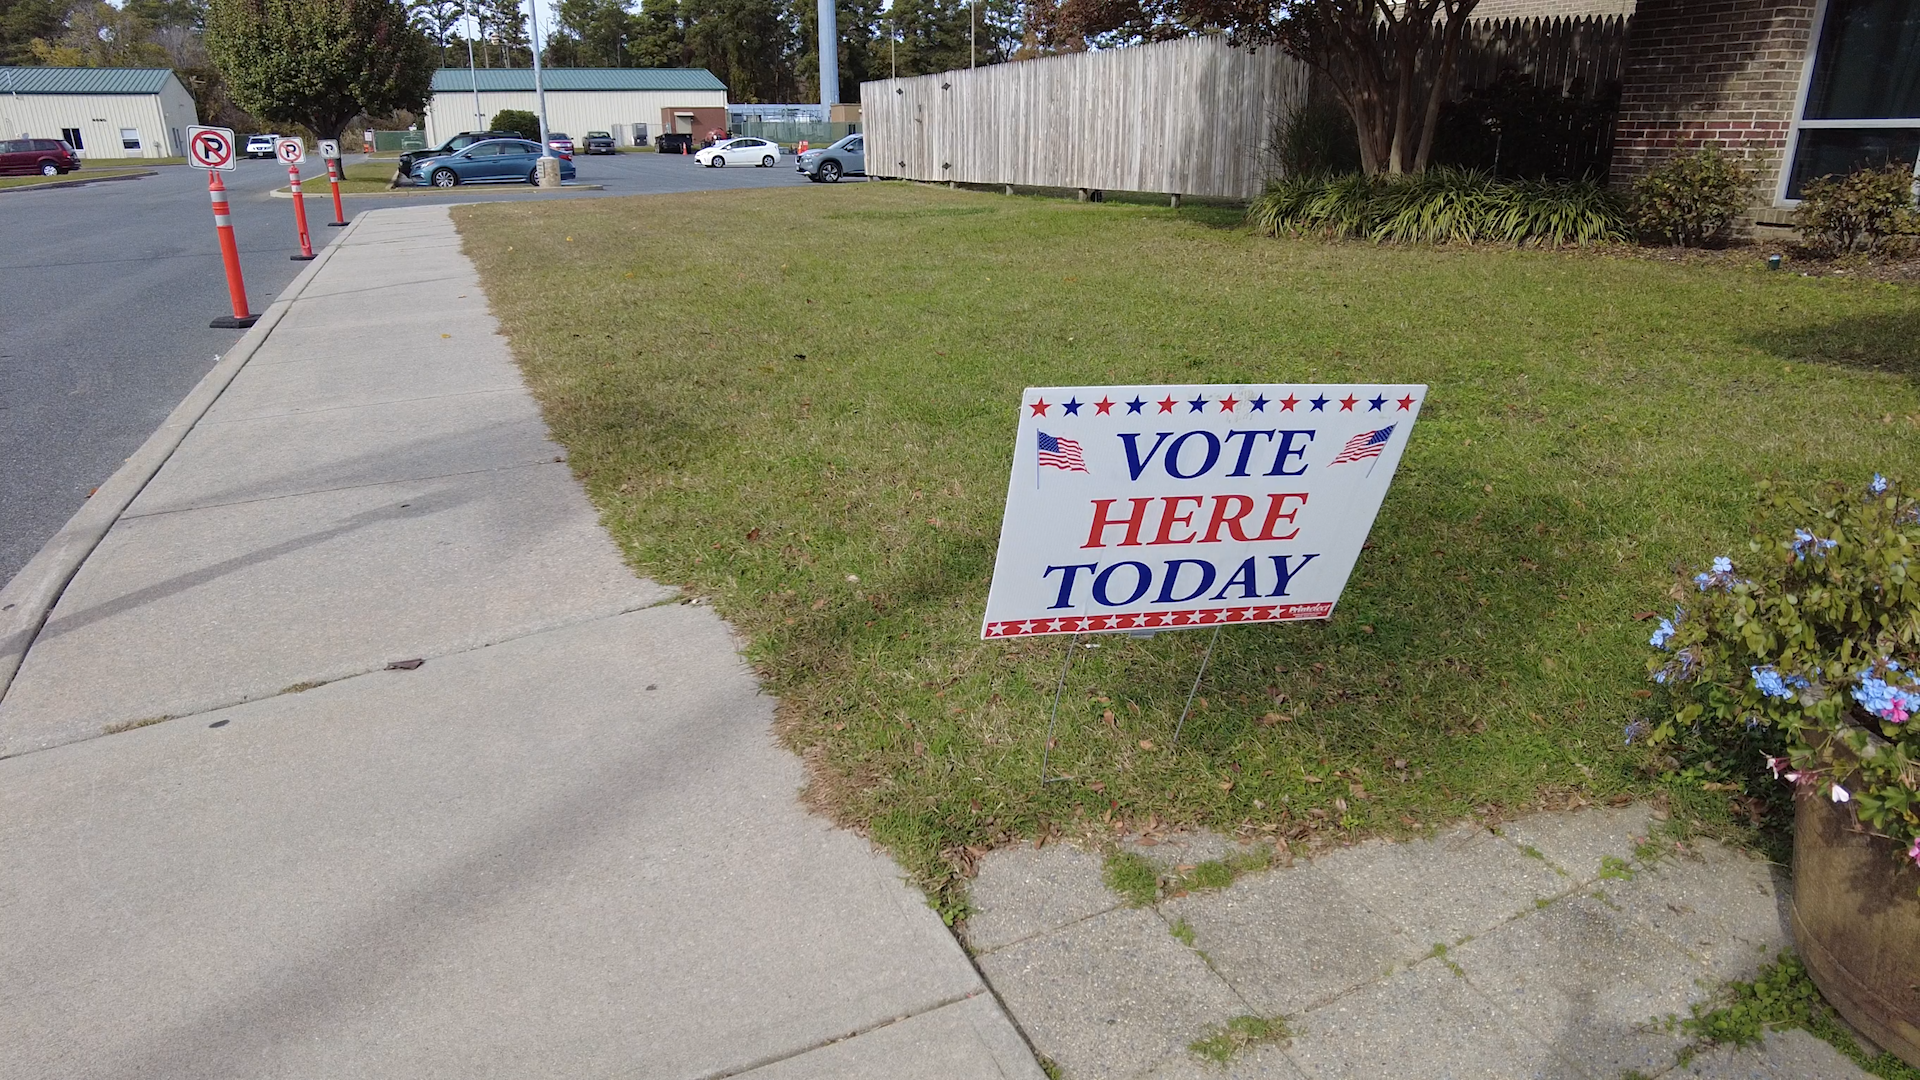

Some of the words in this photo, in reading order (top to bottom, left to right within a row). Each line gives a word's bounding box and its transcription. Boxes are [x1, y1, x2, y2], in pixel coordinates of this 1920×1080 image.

[203, 137, 223, 159] P
[285, 144, 297, 158] P
[1117, 429, 1316, 481] VOTE
[1080, 493, 1309, 549] HERE
[1042, 553, 1320, 610] TODAY
